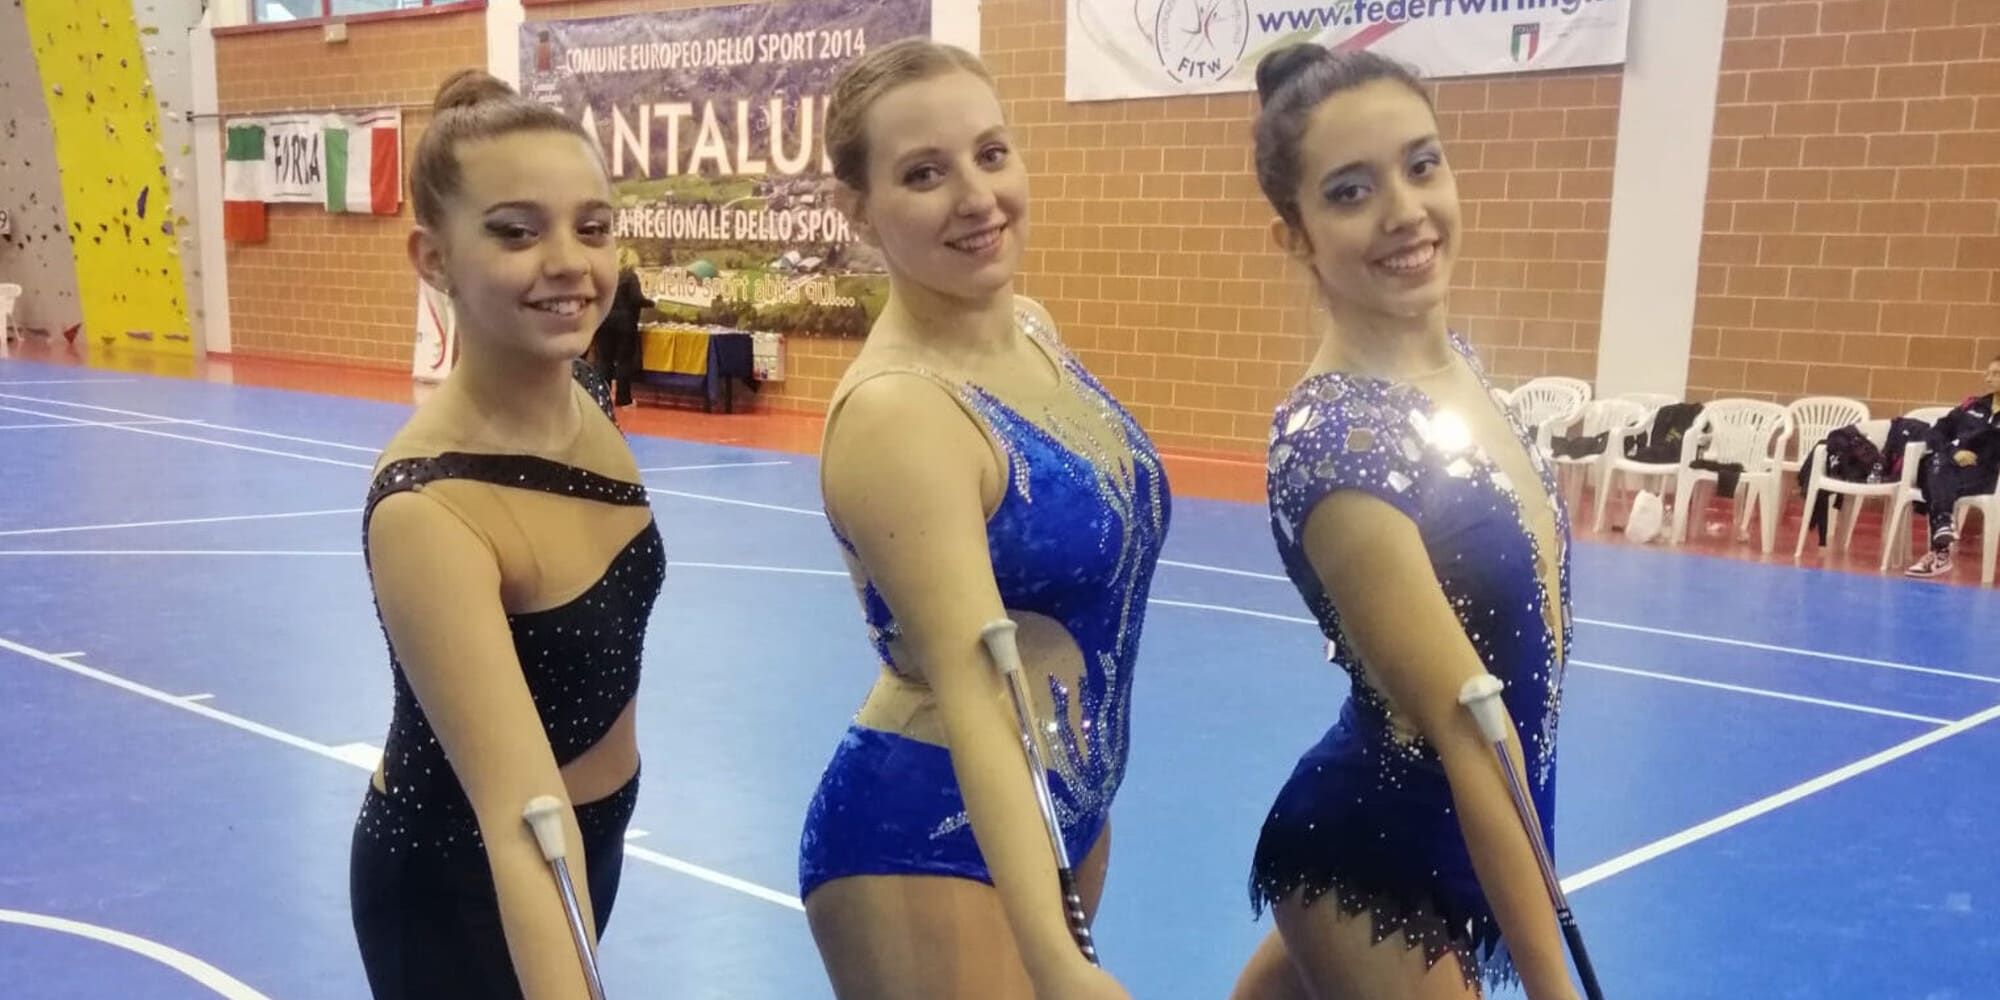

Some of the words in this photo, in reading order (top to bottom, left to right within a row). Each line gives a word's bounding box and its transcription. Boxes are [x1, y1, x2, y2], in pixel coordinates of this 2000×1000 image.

[565, 45, 627, 74] COMUNE
[630, 39, 702, 71] EUROPEO
[705, 36, 755, 66] DELLO
[758, 29, 817, 63] SPORT
[819, 27, 867, 60] 2014
[1177, 56, 1221, 78] FITW
[633, 207, 731, 240] REGIONALE
[735, 209, 793, 241] DELLO
[797, 209, 860, 243] SPOR
[701, 274, 749, 305] sport
